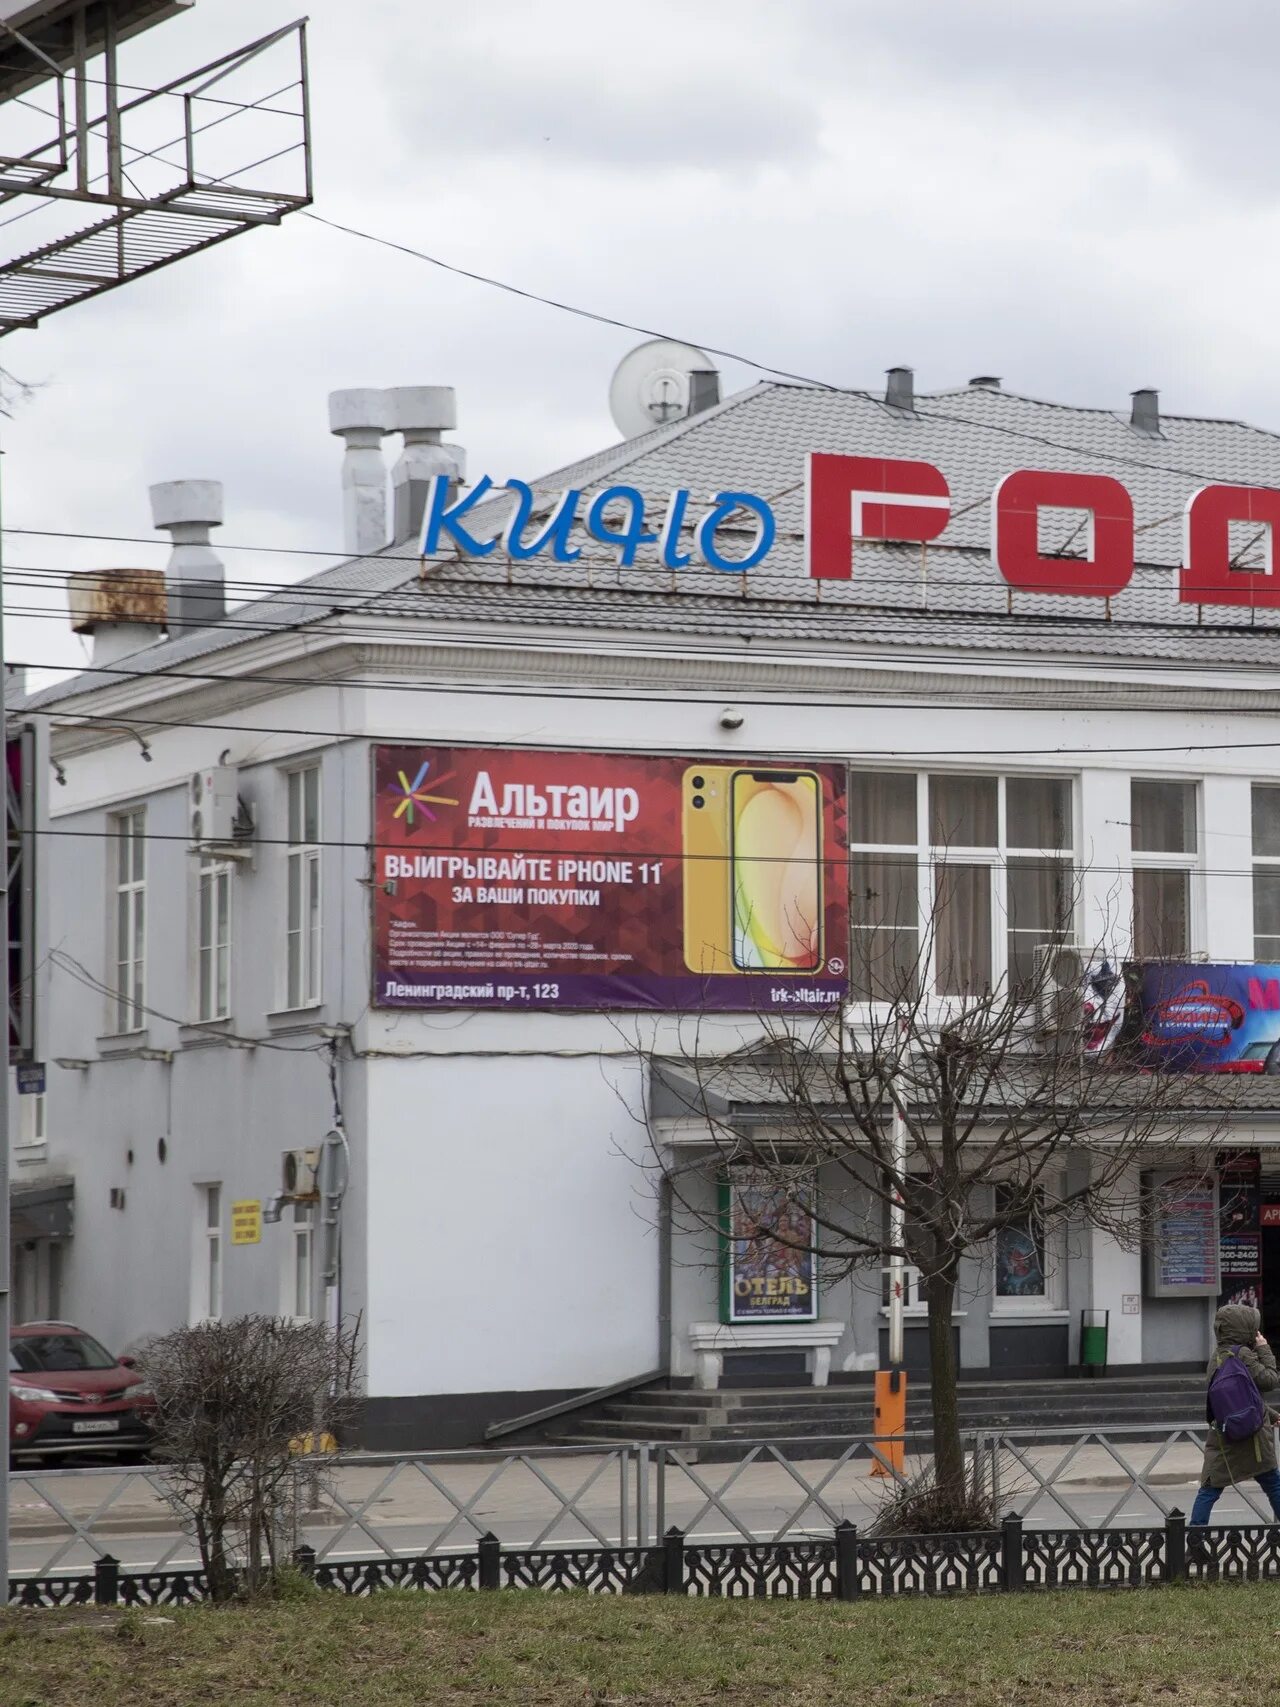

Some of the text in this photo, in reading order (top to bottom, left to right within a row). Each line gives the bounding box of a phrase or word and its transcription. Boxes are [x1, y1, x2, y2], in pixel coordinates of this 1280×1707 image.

[468, 771, 640, 832] Альтаир
[385, 852, 552, 882] ВЫИГРЫВАЙТЕ
[558, 861, 633, 884] iPHONE
[452, 886, 600, 906] ЗА ВАШИ ПОКУПКИ
[385, 981, 559, 1000] Ленинградский пр-т, 123
[735, 1275, 809, 1296] ОТЕЛЬ
[750, 1297, 790, 1307] БЕЛГРАД
